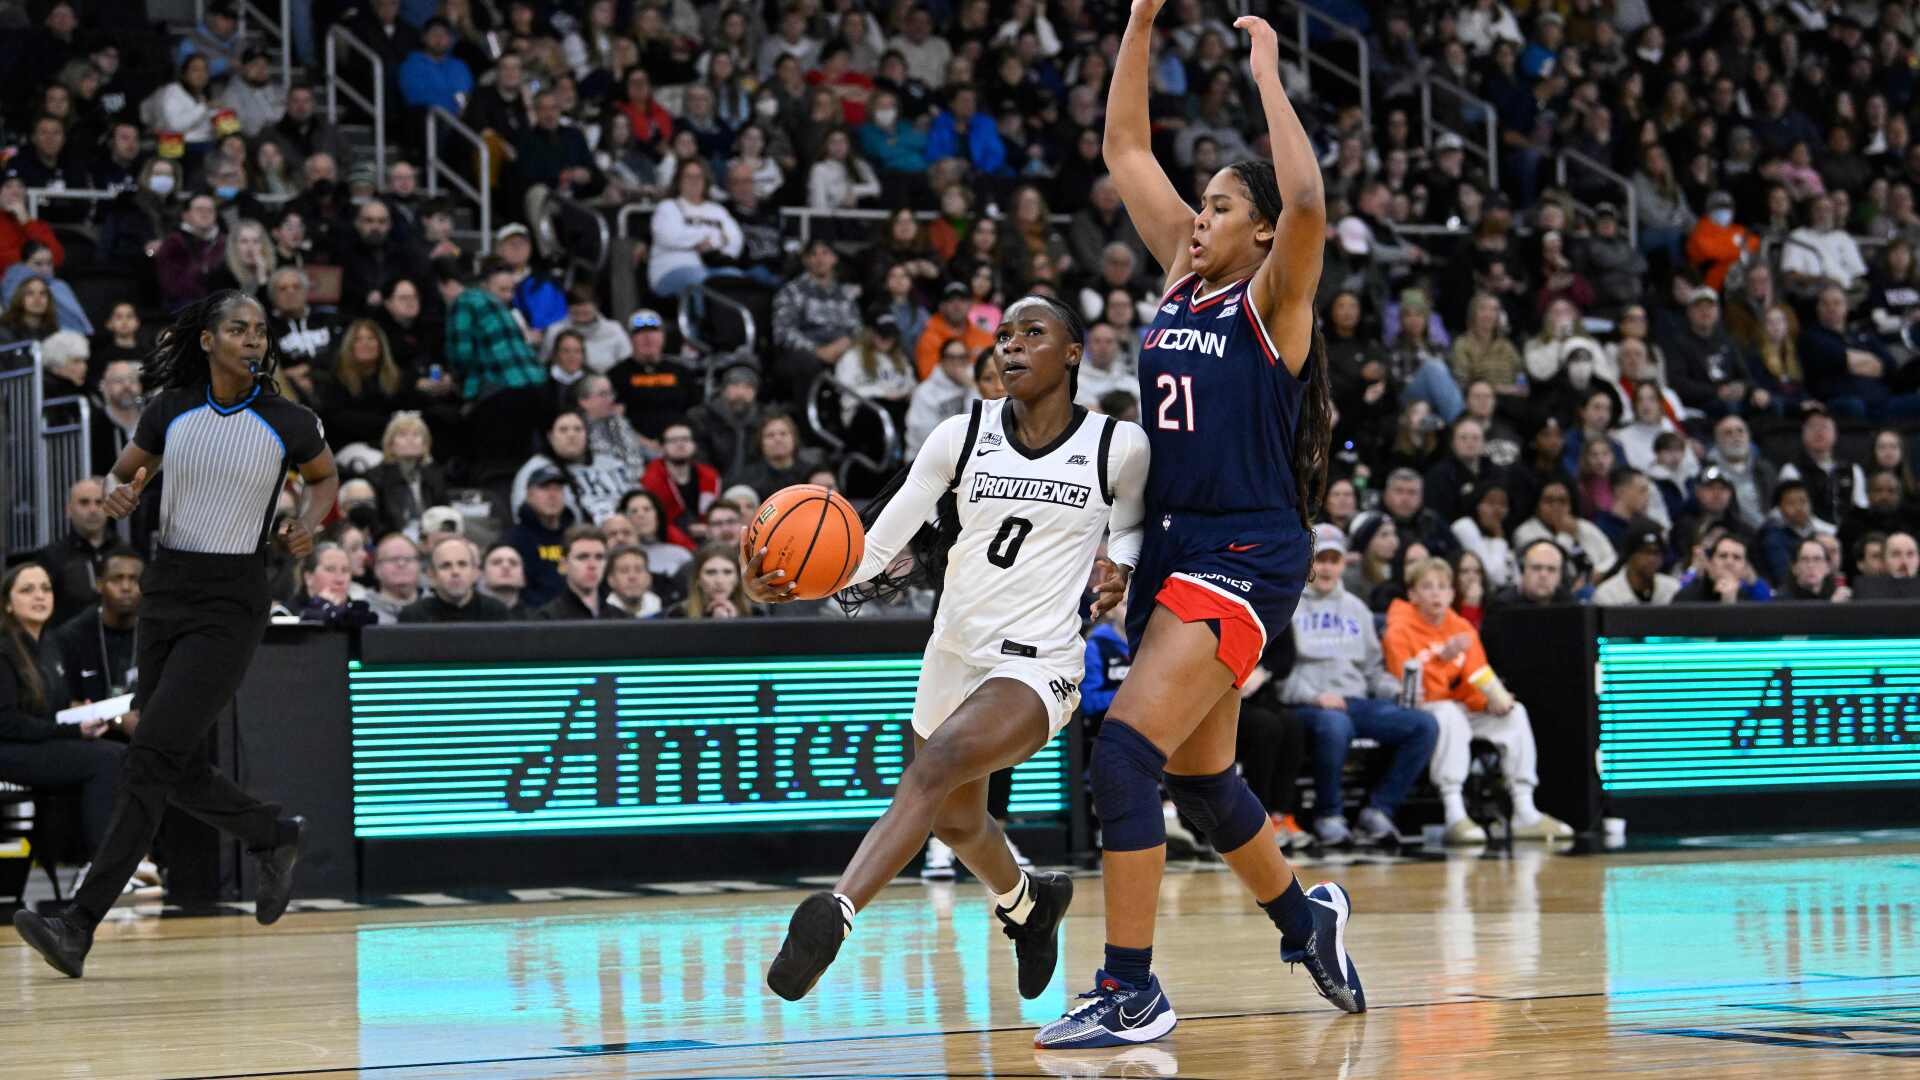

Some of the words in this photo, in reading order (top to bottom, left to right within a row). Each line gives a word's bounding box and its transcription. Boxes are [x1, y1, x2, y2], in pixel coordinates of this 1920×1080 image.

[1144, 328, 1226, 358] UCONN
[1156, 372, 1195, 432] 21
[969, 472, 1091, 509] PROVIDENCE
[987, 516, 1033, 570] 0
